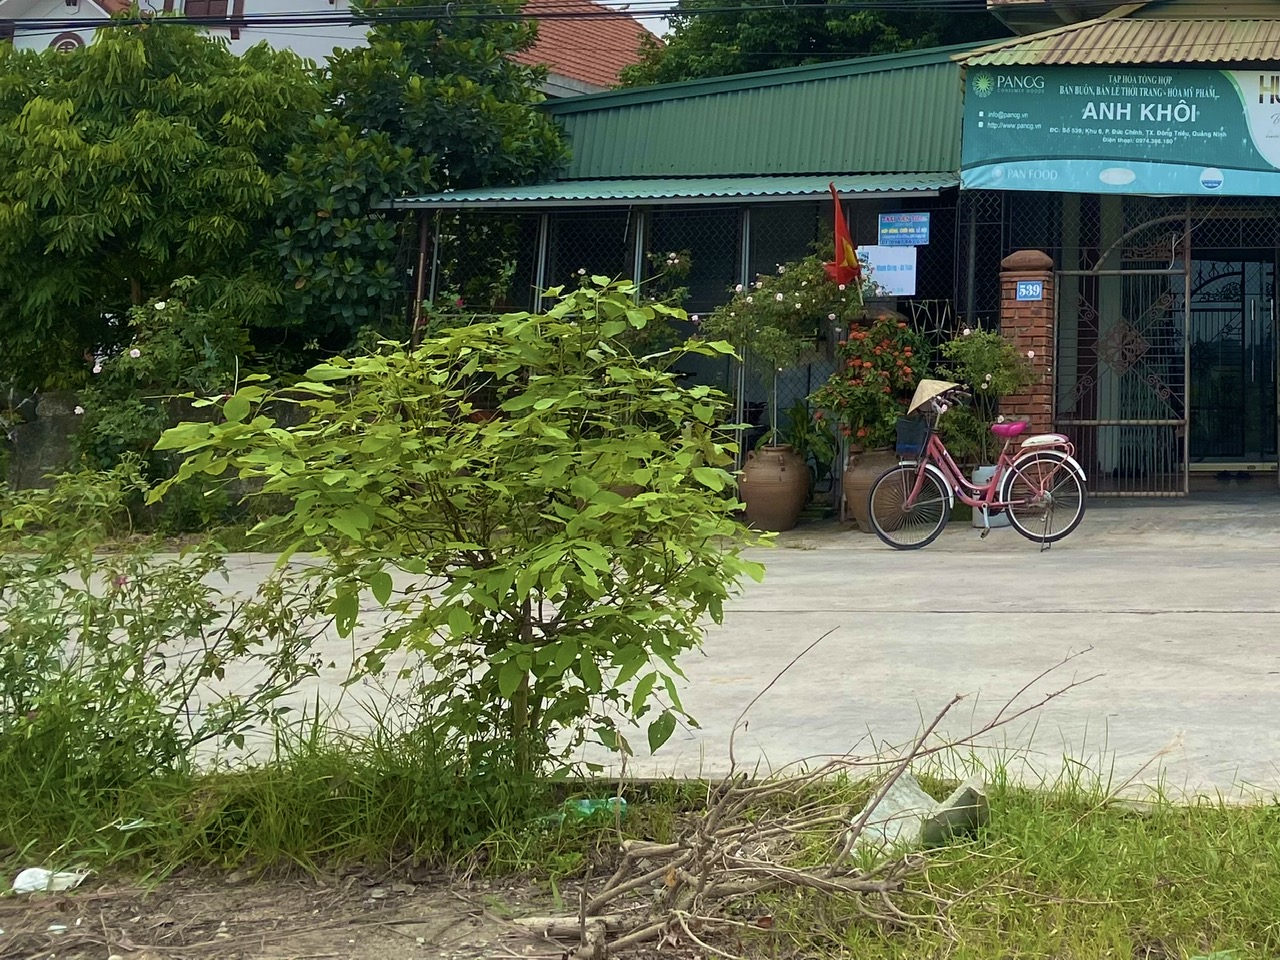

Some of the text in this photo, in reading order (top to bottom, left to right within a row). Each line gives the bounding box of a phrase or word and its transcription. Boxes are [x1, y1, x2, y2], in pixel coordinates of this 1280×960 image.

[1059, 83, 1073, 95] BÁN
[1139, 87, 1163, 97] TRANG
[1081, 99, 1197, 122] ANH KHÔI
[1007, 168, 1058, 180] PAN FOOD
[1019, 284, 1040, 296] 539
